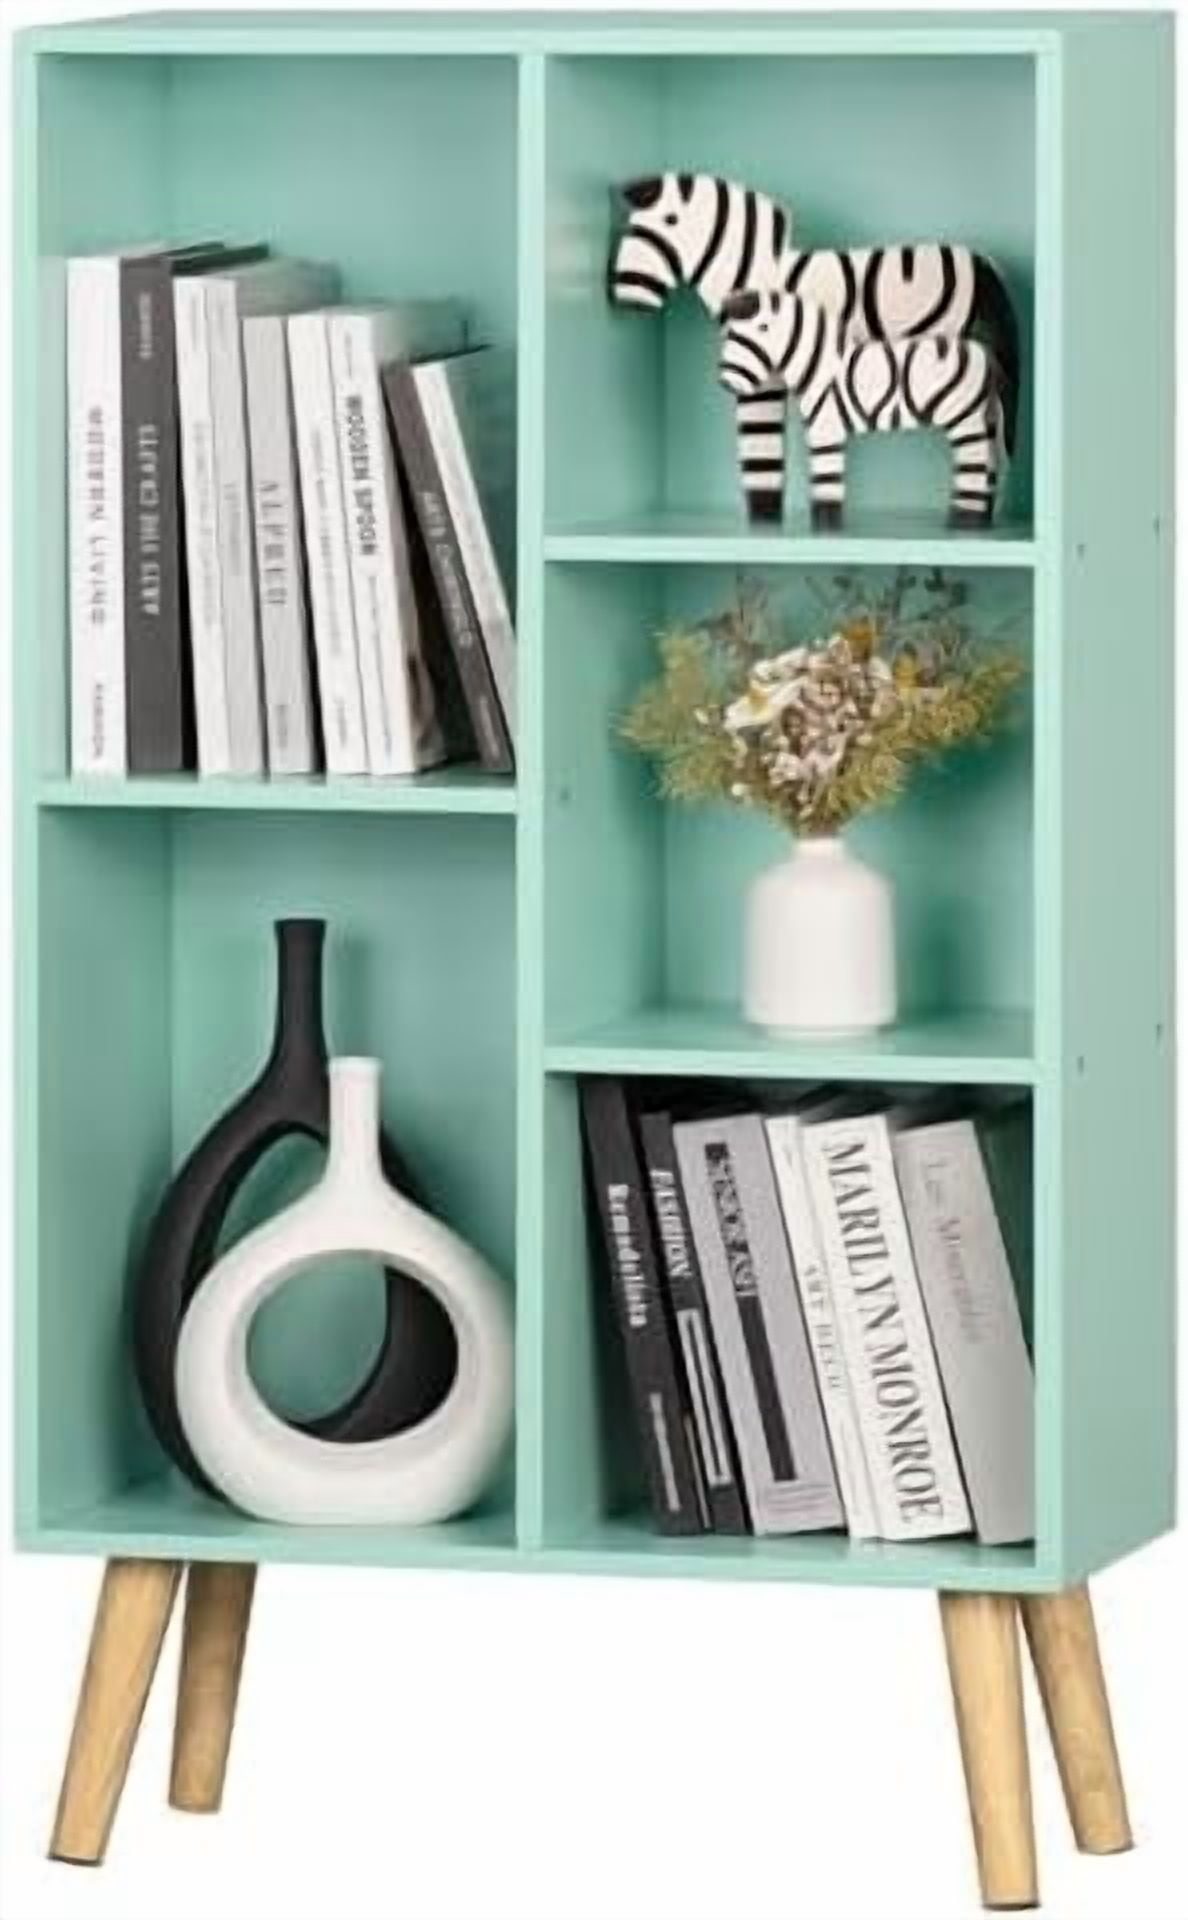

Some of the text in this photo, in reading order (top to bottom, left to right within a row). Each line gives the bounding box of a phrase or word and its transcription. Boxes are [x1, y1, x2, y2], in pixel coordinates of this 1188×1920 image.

[345, 394, 370, 481] WOODEN
[353, 487, 378, 556] SPOON
[650, 1168, 693, 1279] FASHION
[821, 1141, 944, 1524] MARILYN MONROE
